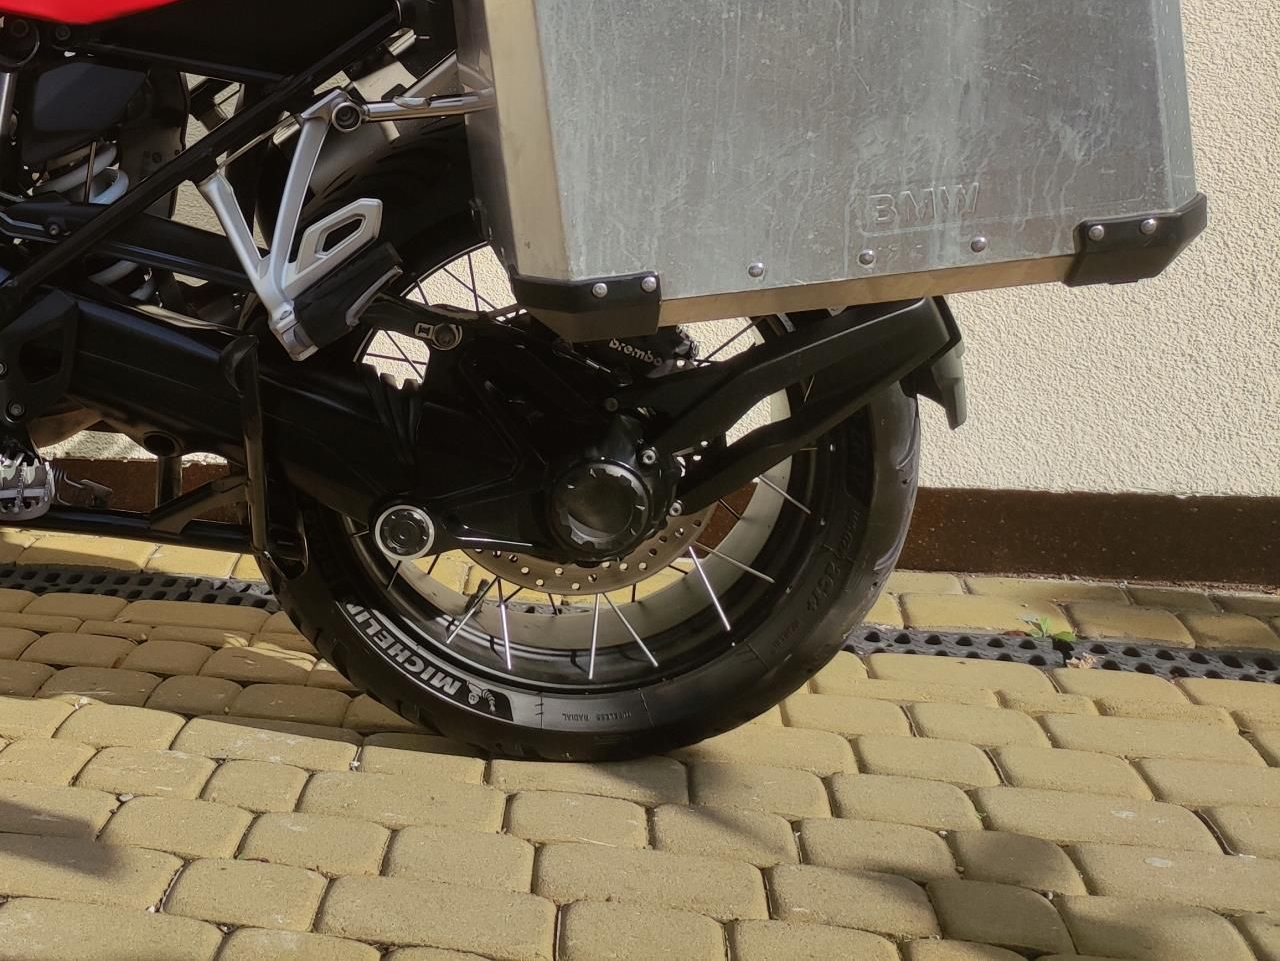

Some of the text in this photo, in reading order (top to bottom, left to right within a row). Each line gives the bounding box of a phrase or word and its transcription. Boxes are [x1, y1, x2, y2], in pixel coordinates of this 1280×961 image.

[869, 182, 979, 222] BMW
[608, 338, 663, 367] brembo
[561, 711, 590, 722] RADIAL
